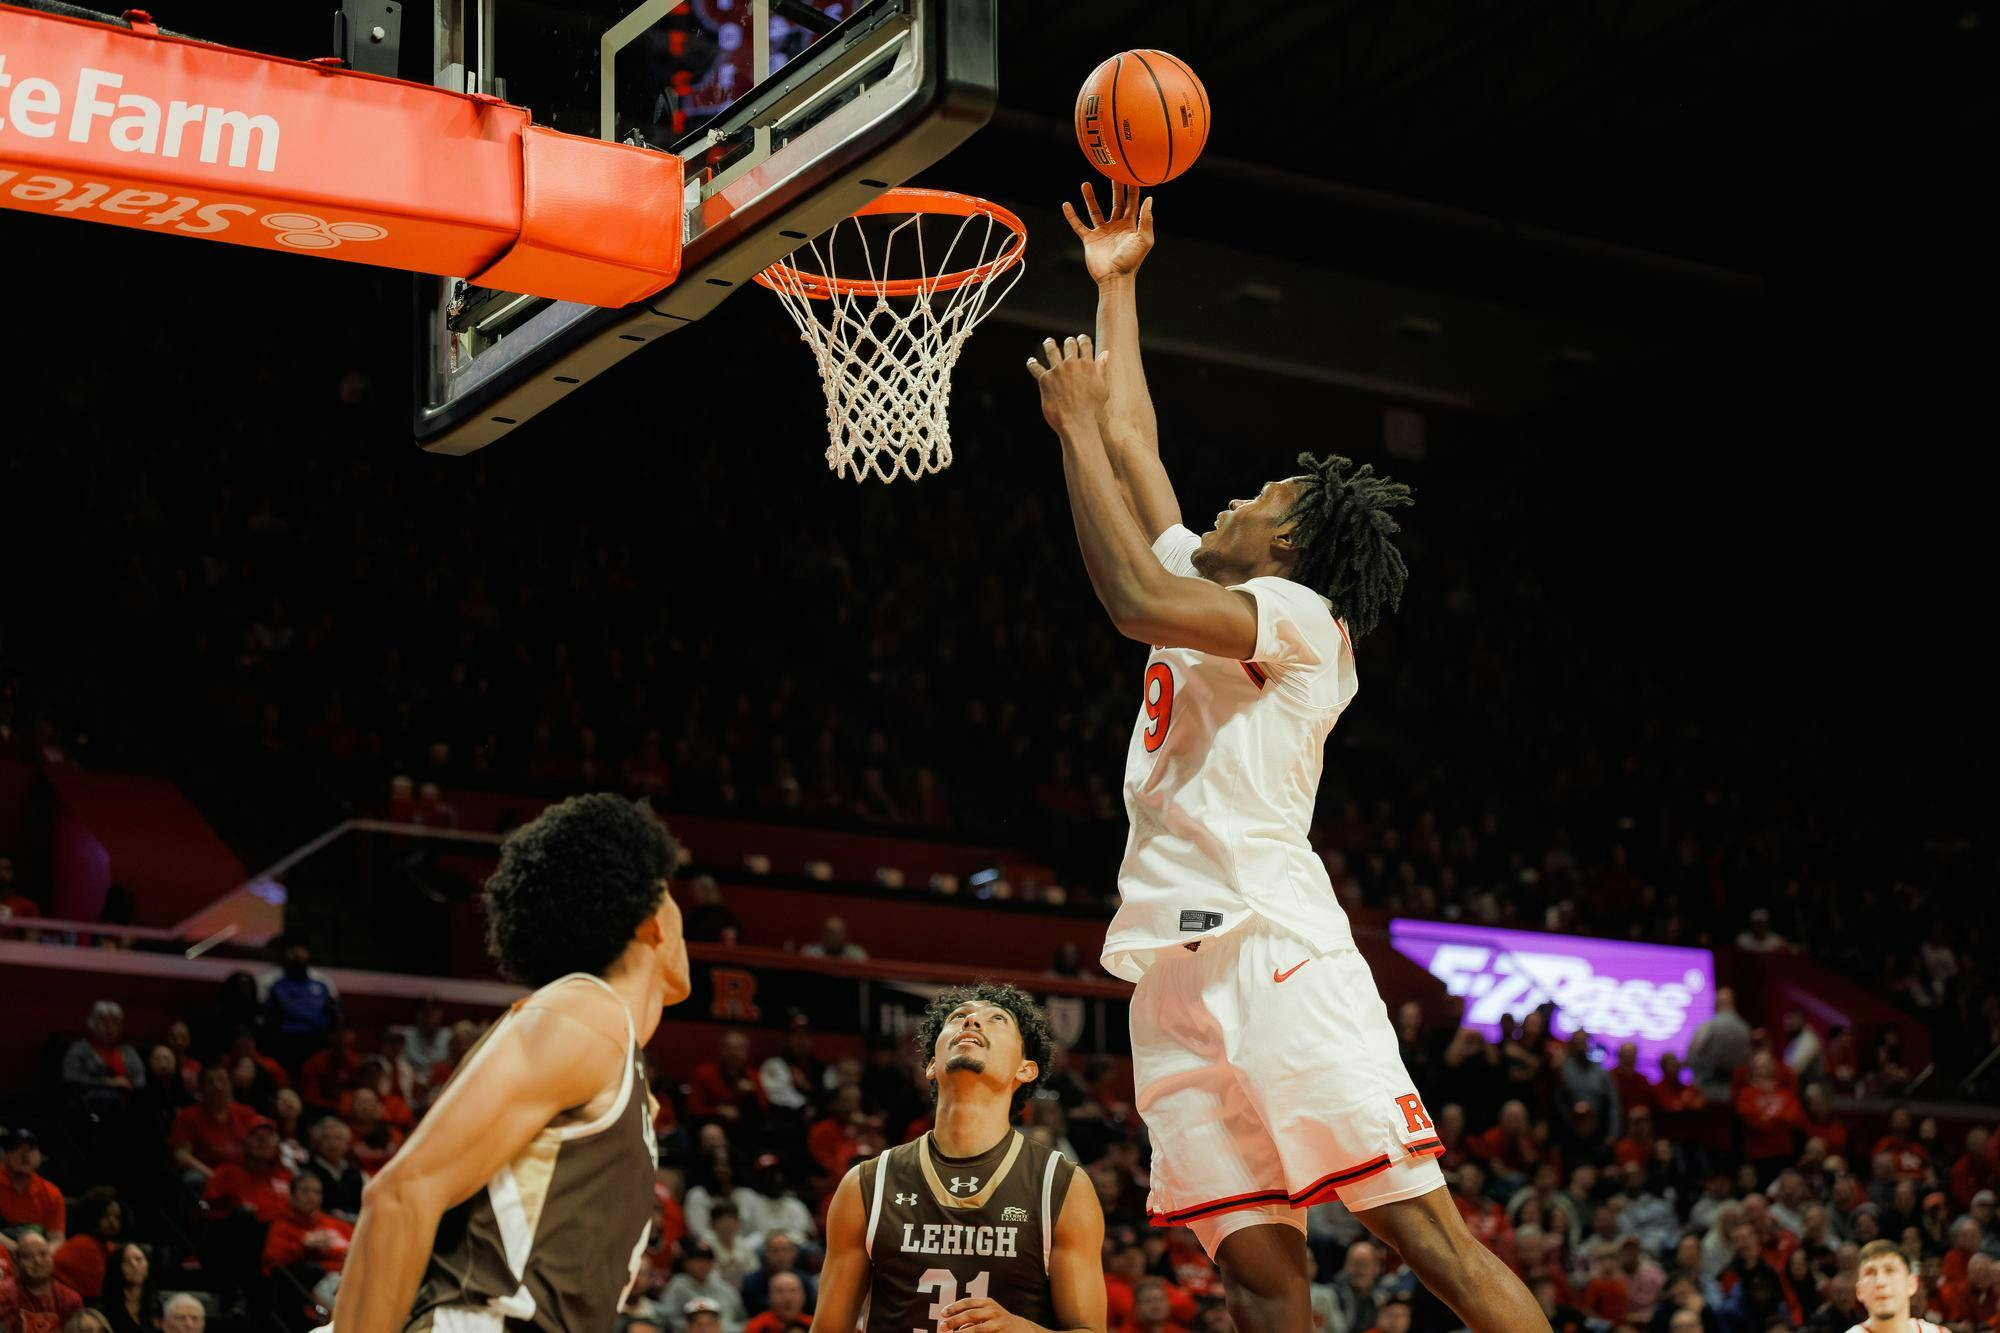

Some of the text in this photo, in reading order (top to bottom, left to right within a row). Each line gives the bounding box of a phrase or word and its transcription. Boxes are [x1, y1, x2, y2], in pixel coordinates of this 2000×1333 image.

[1085, 95, 1112, 165] ELITE
[1143, 661, 1174, 753] 9
[711, 968, 761, 1022] R
[1394, 1092, 1433, 1134] R
[900, 1223, 1018, 1258] LEHIGH
